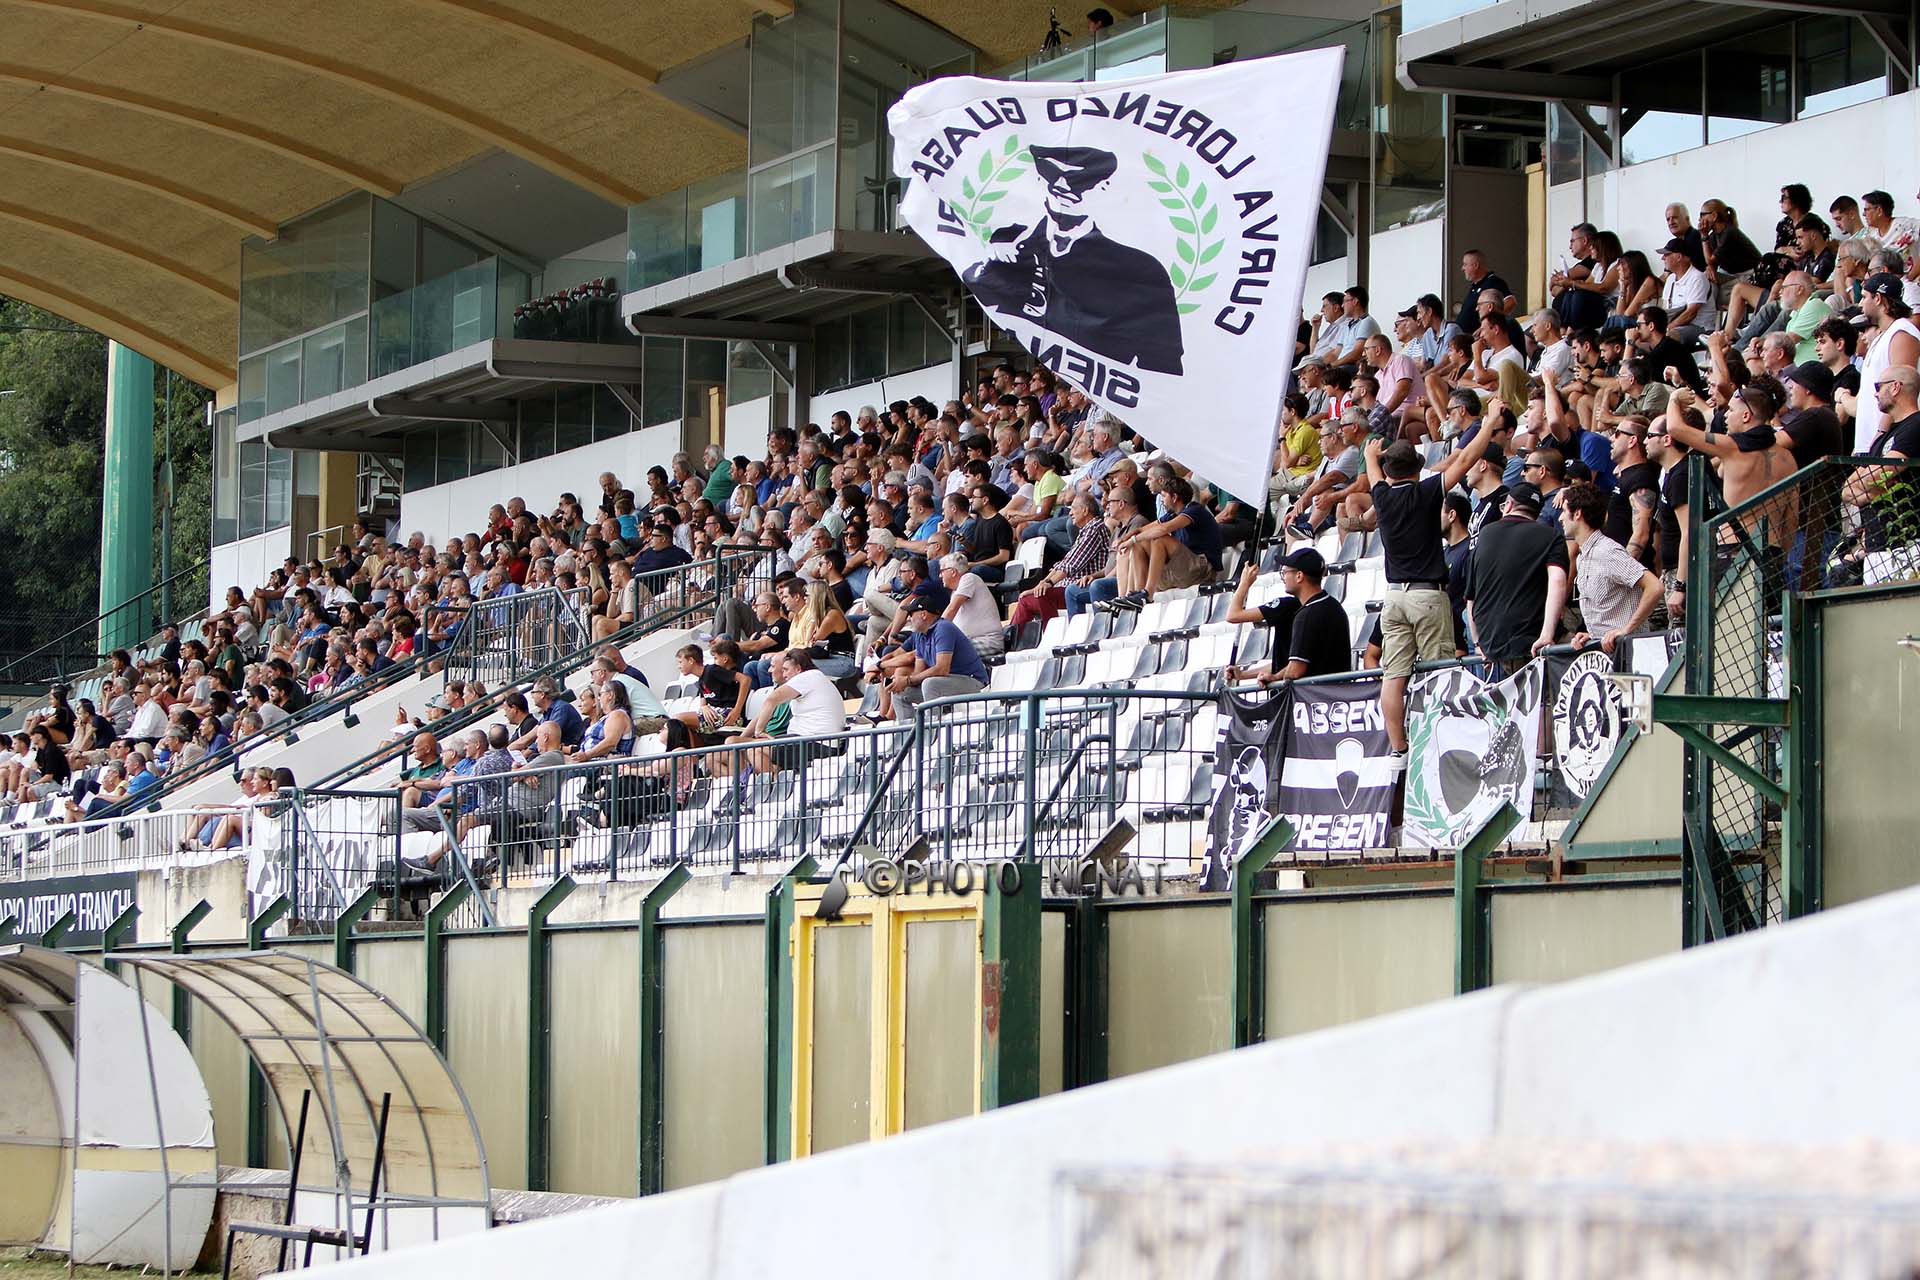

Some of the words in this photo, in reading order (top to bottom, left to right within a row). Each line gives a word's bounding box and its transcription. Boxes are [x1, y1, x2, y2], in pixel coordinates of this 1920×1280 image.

[1293, 700, 1386, 735] ASSEN
[26, 892, 77, 935] ARTEMIO
[78, 888, 131, 932] FRANCHI
